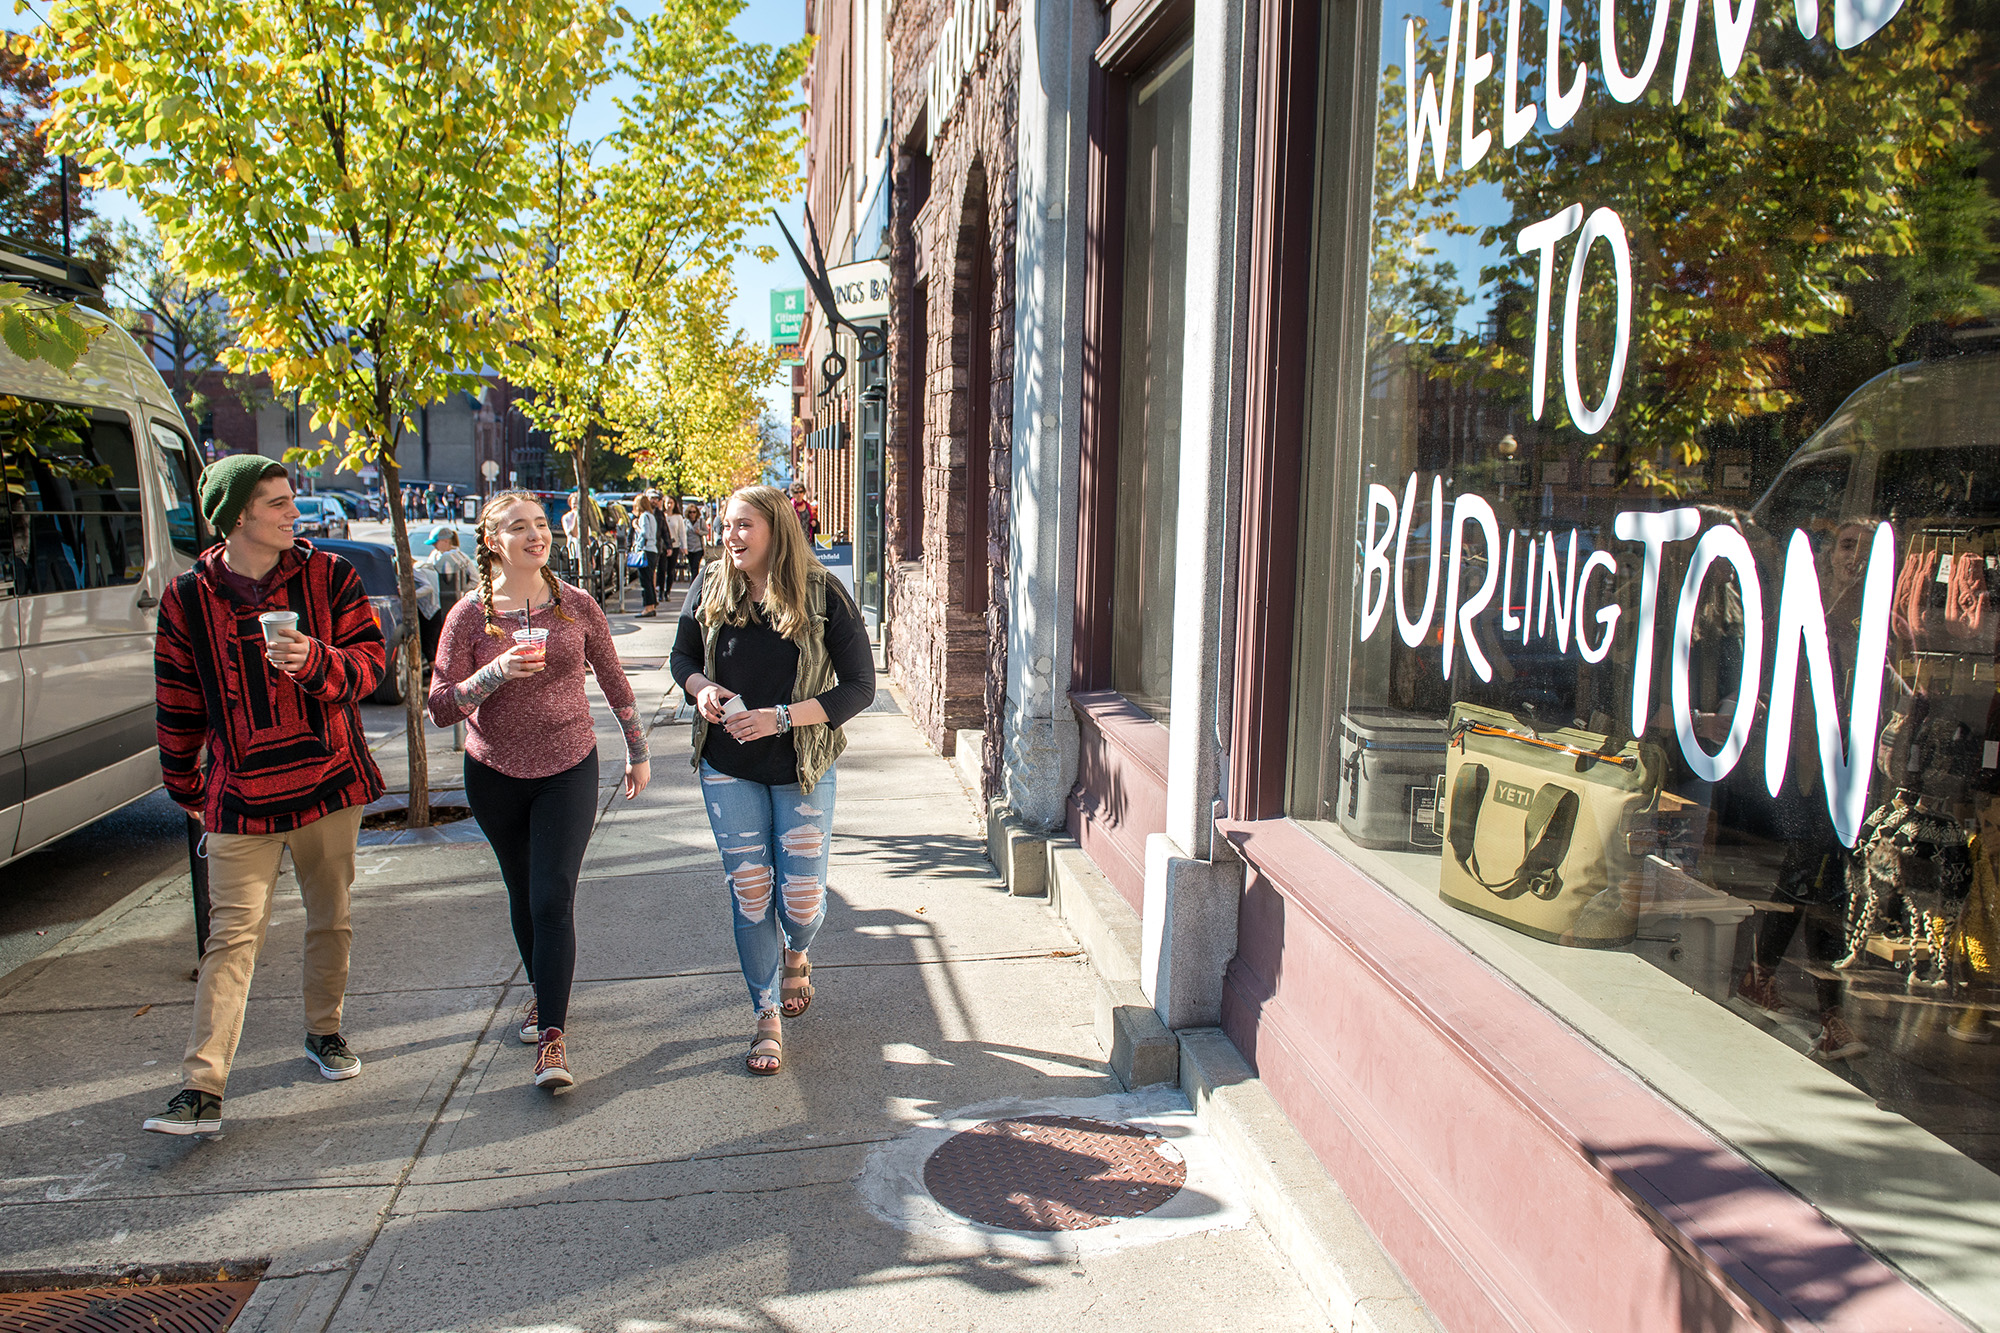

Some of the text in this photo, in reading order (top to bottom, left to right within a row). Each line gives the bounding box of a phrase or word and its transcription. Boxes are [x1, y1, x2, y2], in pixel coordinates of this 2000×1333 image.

[1404, 0, 1905, 191] WELCO
[1516, 202, 1633, 436] TO
[1360, 471, 1896, 849] BURLINGTON
[1499, 785, 1531, 806] YETI
